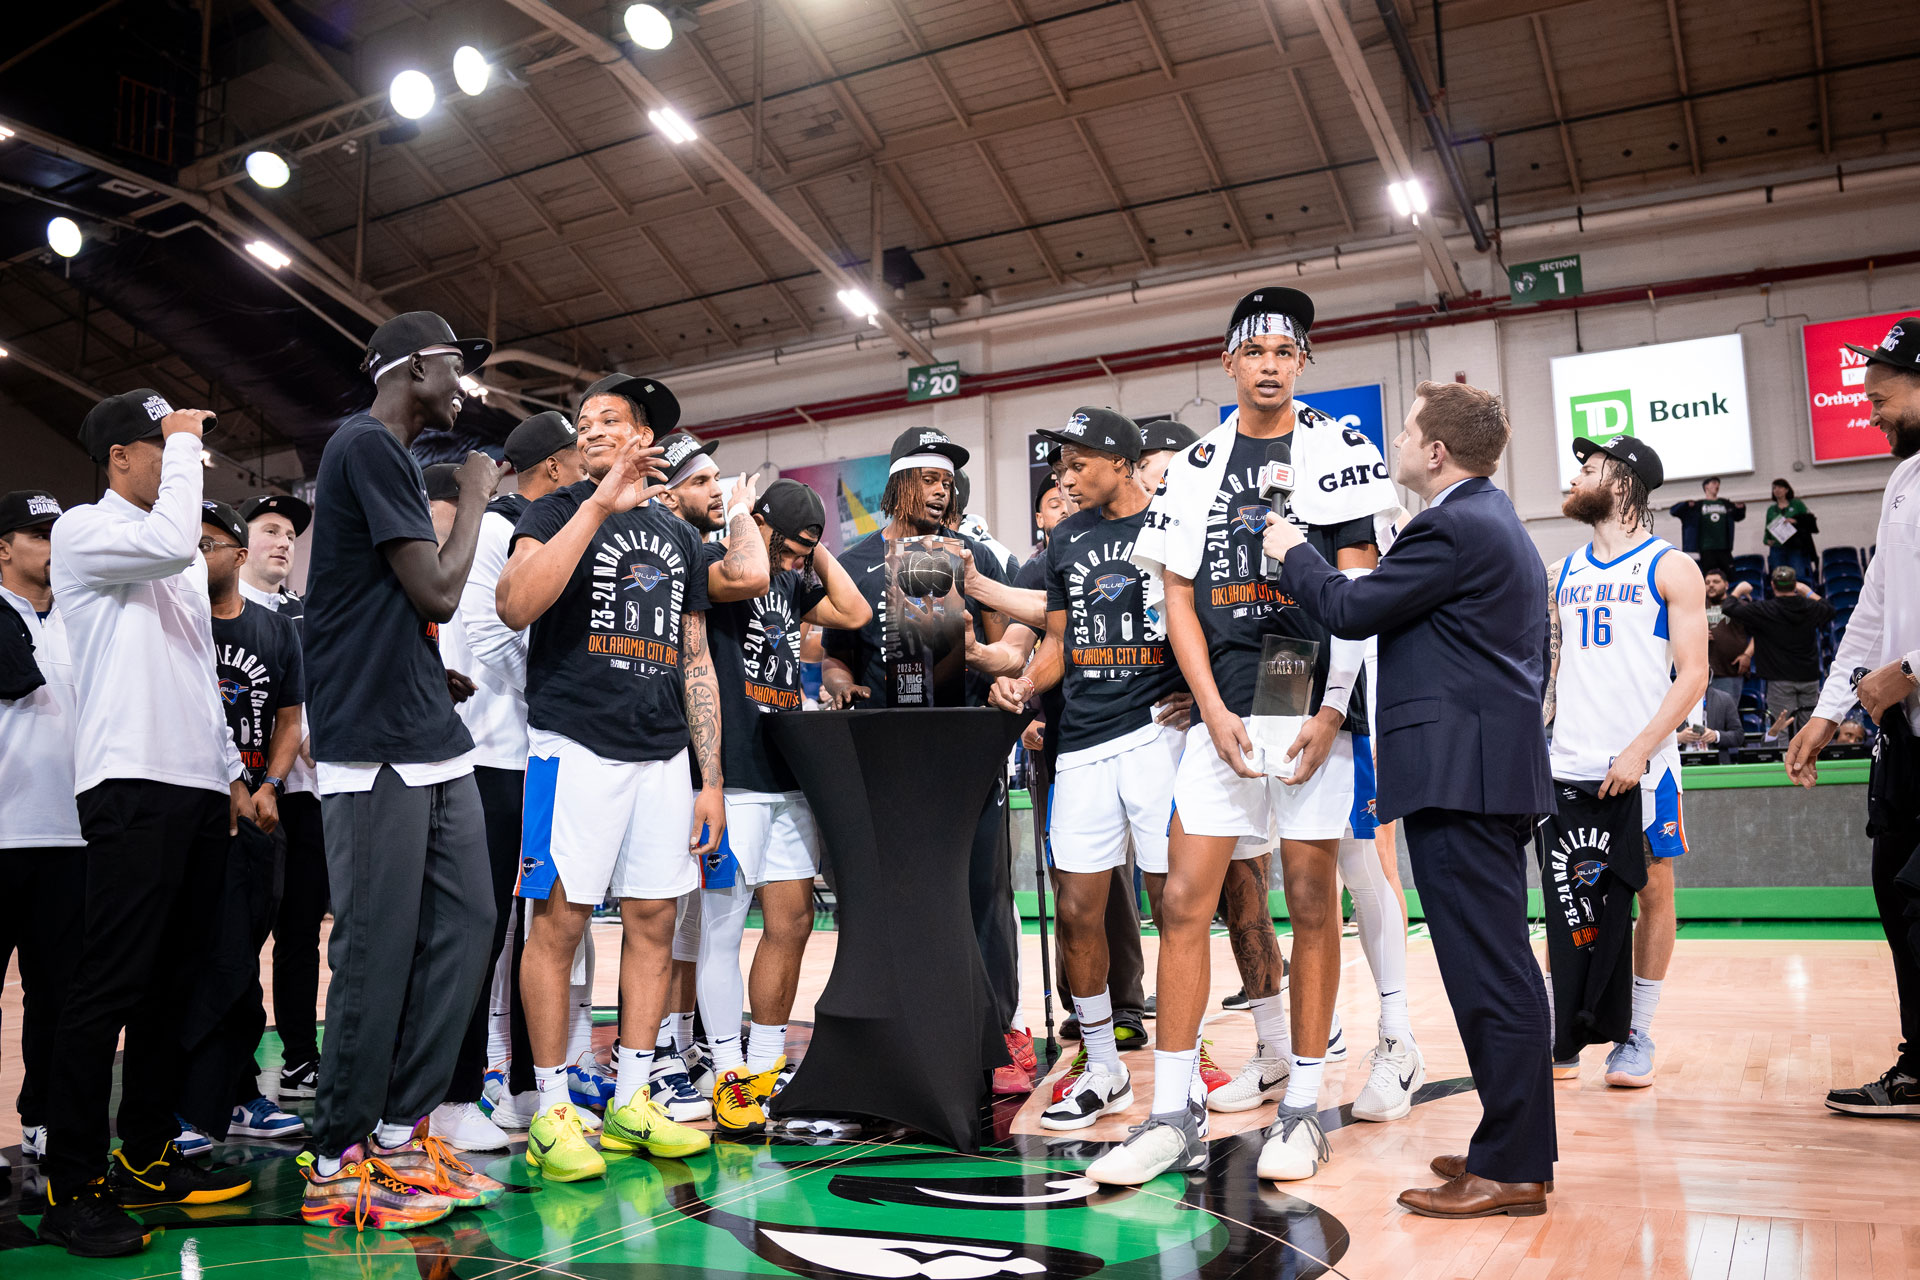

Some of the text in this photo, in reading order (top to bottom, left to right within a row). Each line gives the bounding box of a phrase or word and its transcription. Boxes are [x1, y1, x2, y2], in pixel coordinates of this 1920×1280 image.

[1539, 259, 1577, 272] SECTION
[1554, 272, 1565, 294] 1
[929, 374, 957, 396] 20
[1574, 392, 1729, 438] TD Bank
[613, 533, 632, 552] G
[1206, 473, 1245, 581] 23-24 NBA G
[593, 542, 623, 578] NBA
[628, 529, 685, 576] LEAGUE
[1087, 549, 1101, 567] G
[634, 571, 658, 581] BLUE
[1069, 561, 1091, 597] NBA
[590, 581, 617, 630] 23-24
[1560, 583, 1645, 607] OKC BLUE
[669, 579, 685, 645] CHAMPS
[1072, 599, 1090, 645] 23-24
[1576, 605, 1614, 650] 16
[588, 634, 645, 658] OKLAHOMA
[647, 641, 665, 663] CITY
[743, 633, 766, 679] 23-24
[1071, 647, 1164, 665] OKLAHOMA CITY BLUE
[897, 663, 922, 673] 2023-24
[897, 694, 923, 704] CHAMPIONS
[905, 683, 922, 694] LEAGUE
[250, 689, 269, 747] CHAMPS
[1551, 849, 1569, 883] NBA
[1577, 868, 1600, 876] BLUE
[1557, 884, 1581, 927] 23-24
